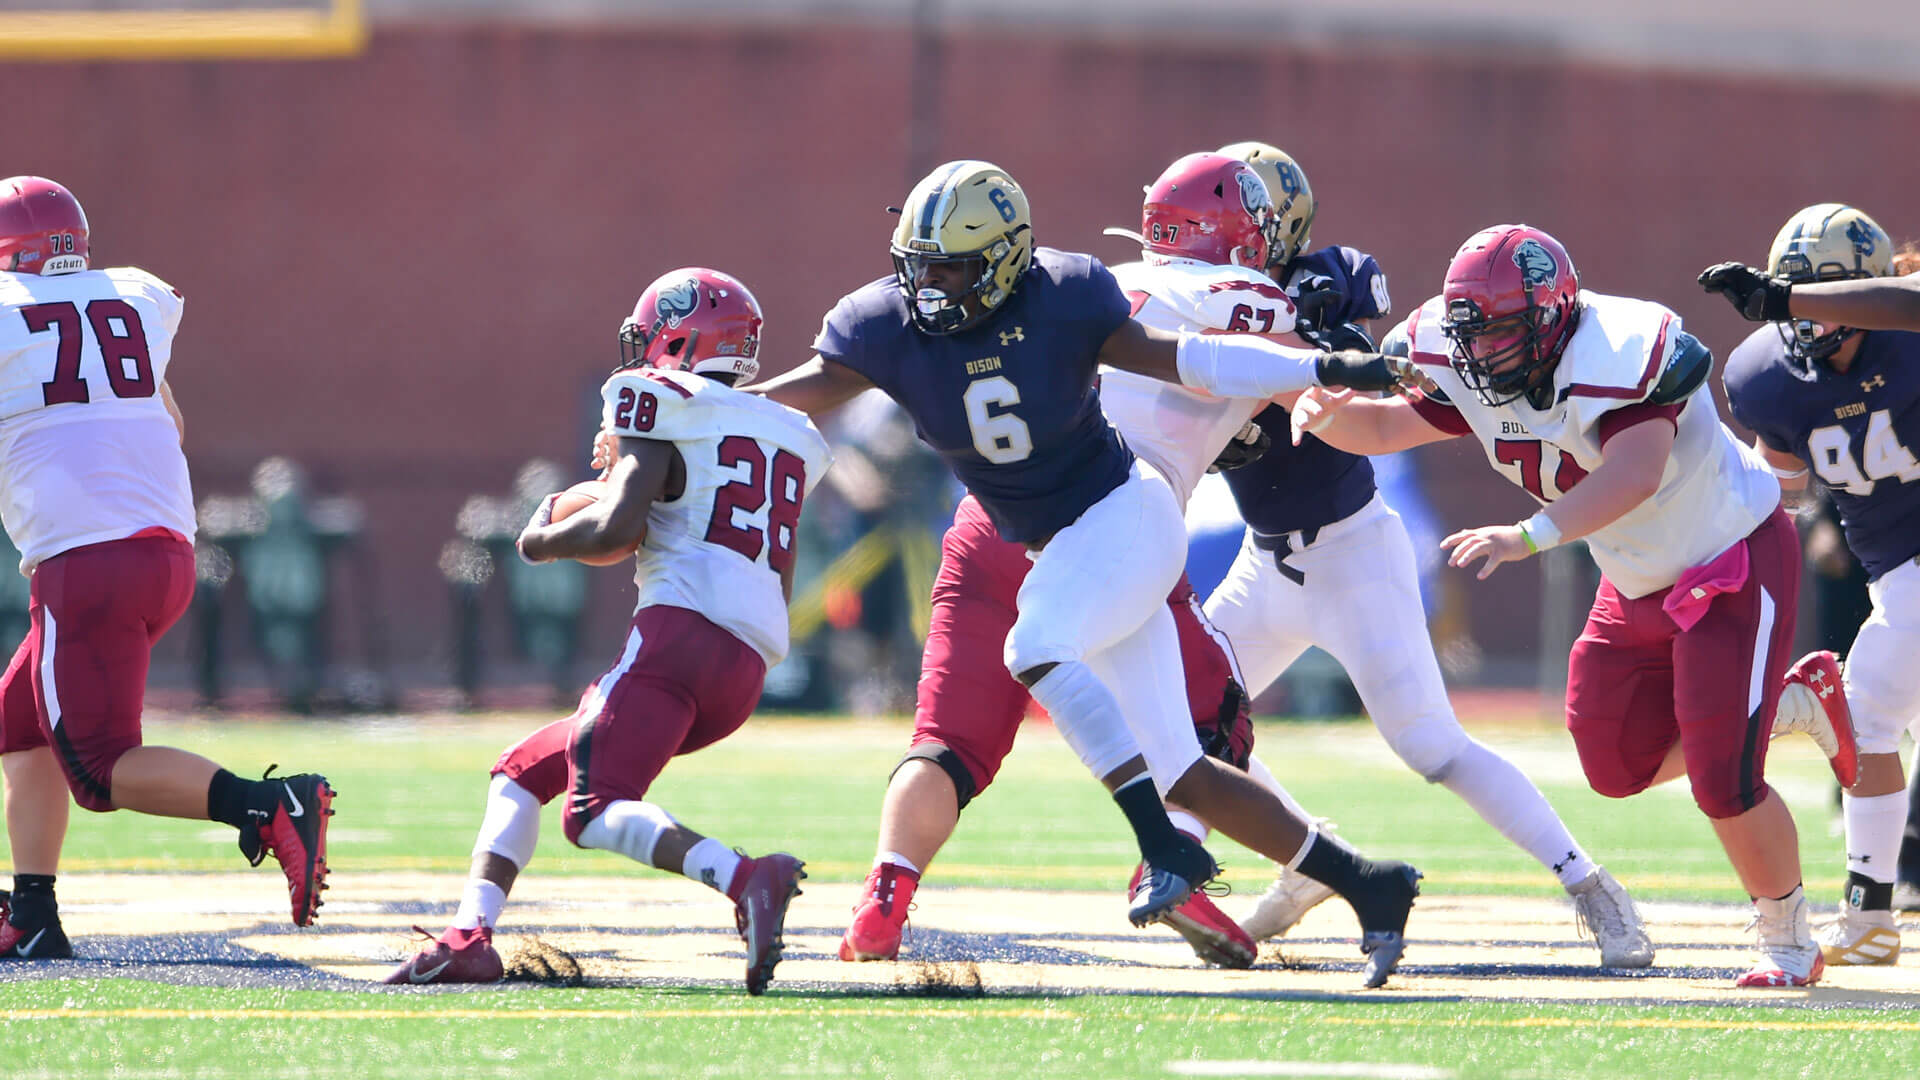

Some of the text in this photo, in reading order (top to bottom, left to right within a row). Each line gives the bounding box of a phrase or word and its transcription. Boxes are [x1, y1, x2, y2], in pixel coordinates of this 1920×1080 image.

[988, 188, 1016, 224] 6
[50, 233, 74, 254] 78
[1227, 303, 1275, 333] 67
[20, 299, 155, 406] 78
[966, 356, 1002, 375] BISON
[615, 387, 658, 433] 28
[963, 375, 1034, 465] 6
[1834, 401, 1867, 420] BISON
[1807, 409, 1920, 497] 94
[704, 435, 807, 574] 28
